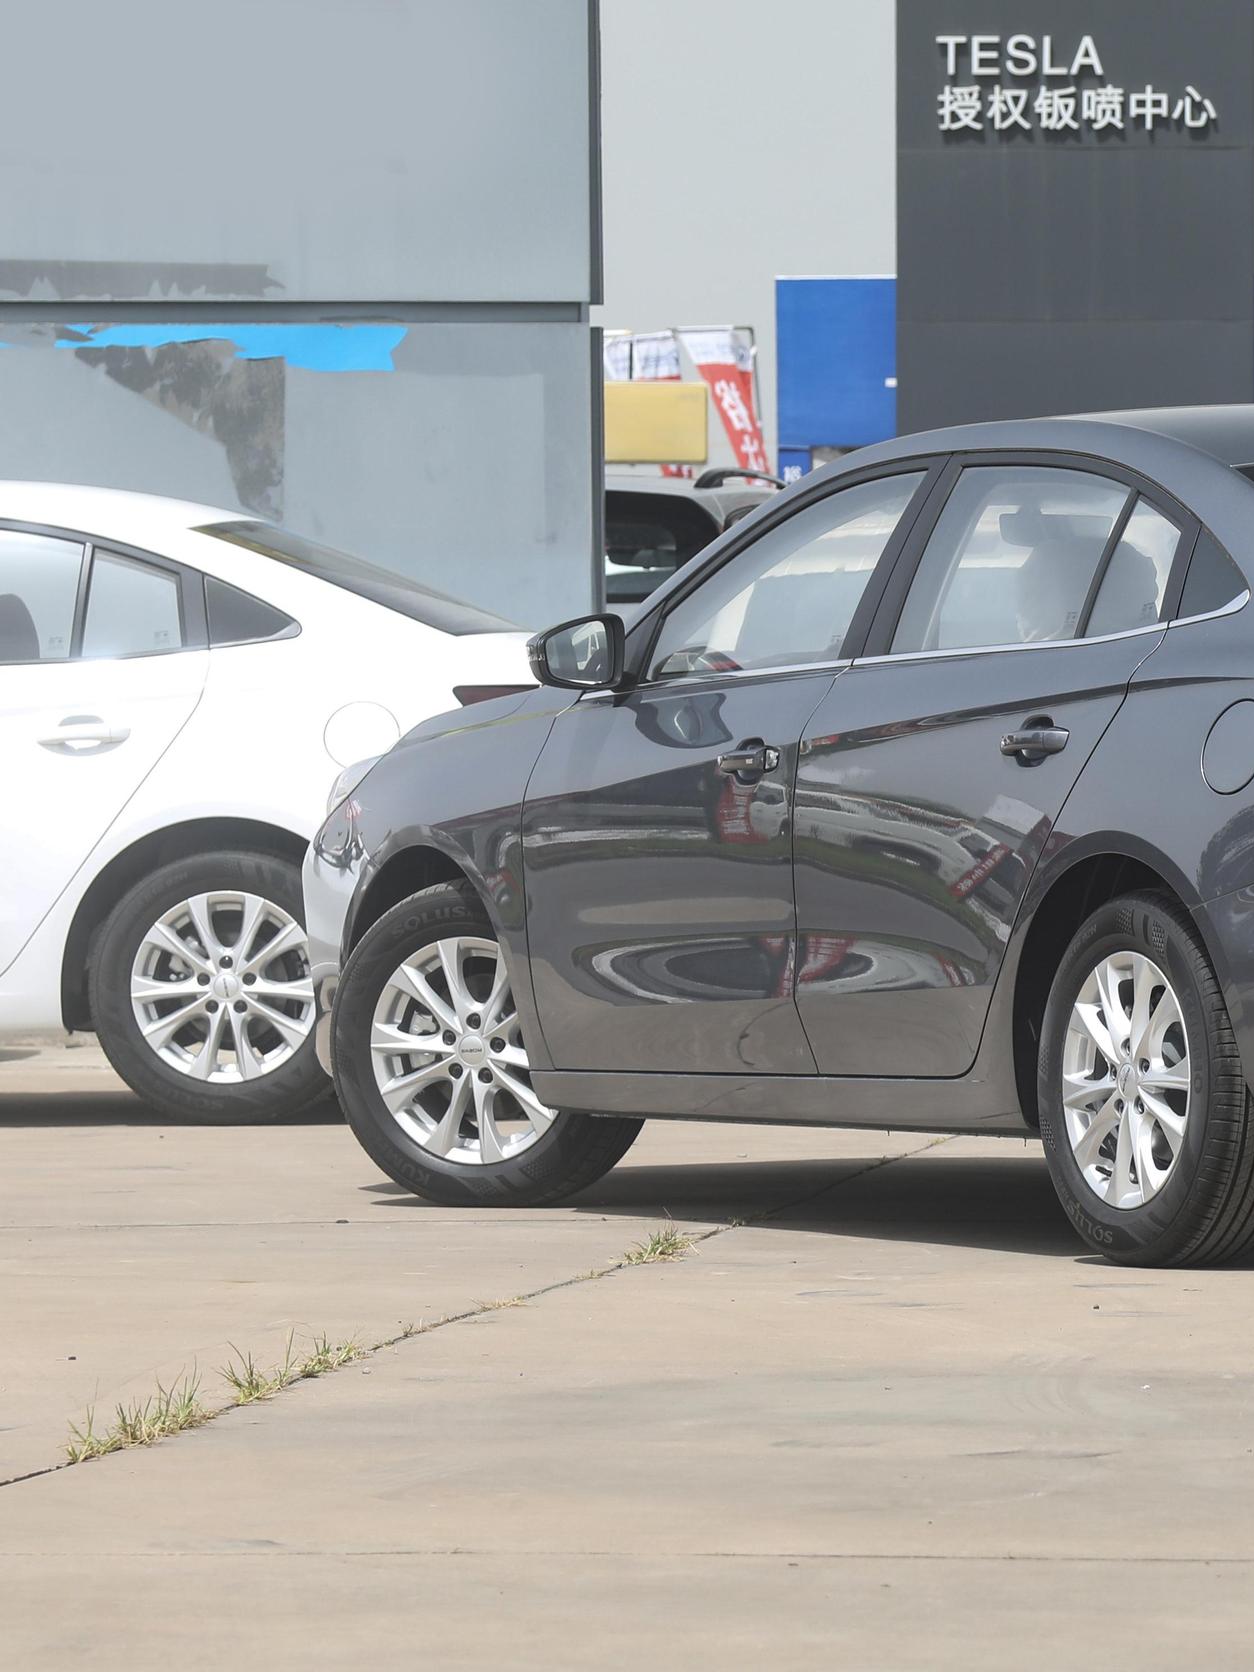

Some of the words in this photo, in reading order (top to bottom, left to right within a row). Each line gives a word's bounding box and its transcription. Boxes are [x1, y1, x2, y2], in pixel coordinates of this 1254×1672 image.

[935, 34, 1104, 76] TESLA
[936, 84, 1218, 131] 授权钣喷中心
[391, 905, 466, 938] SOLUS
